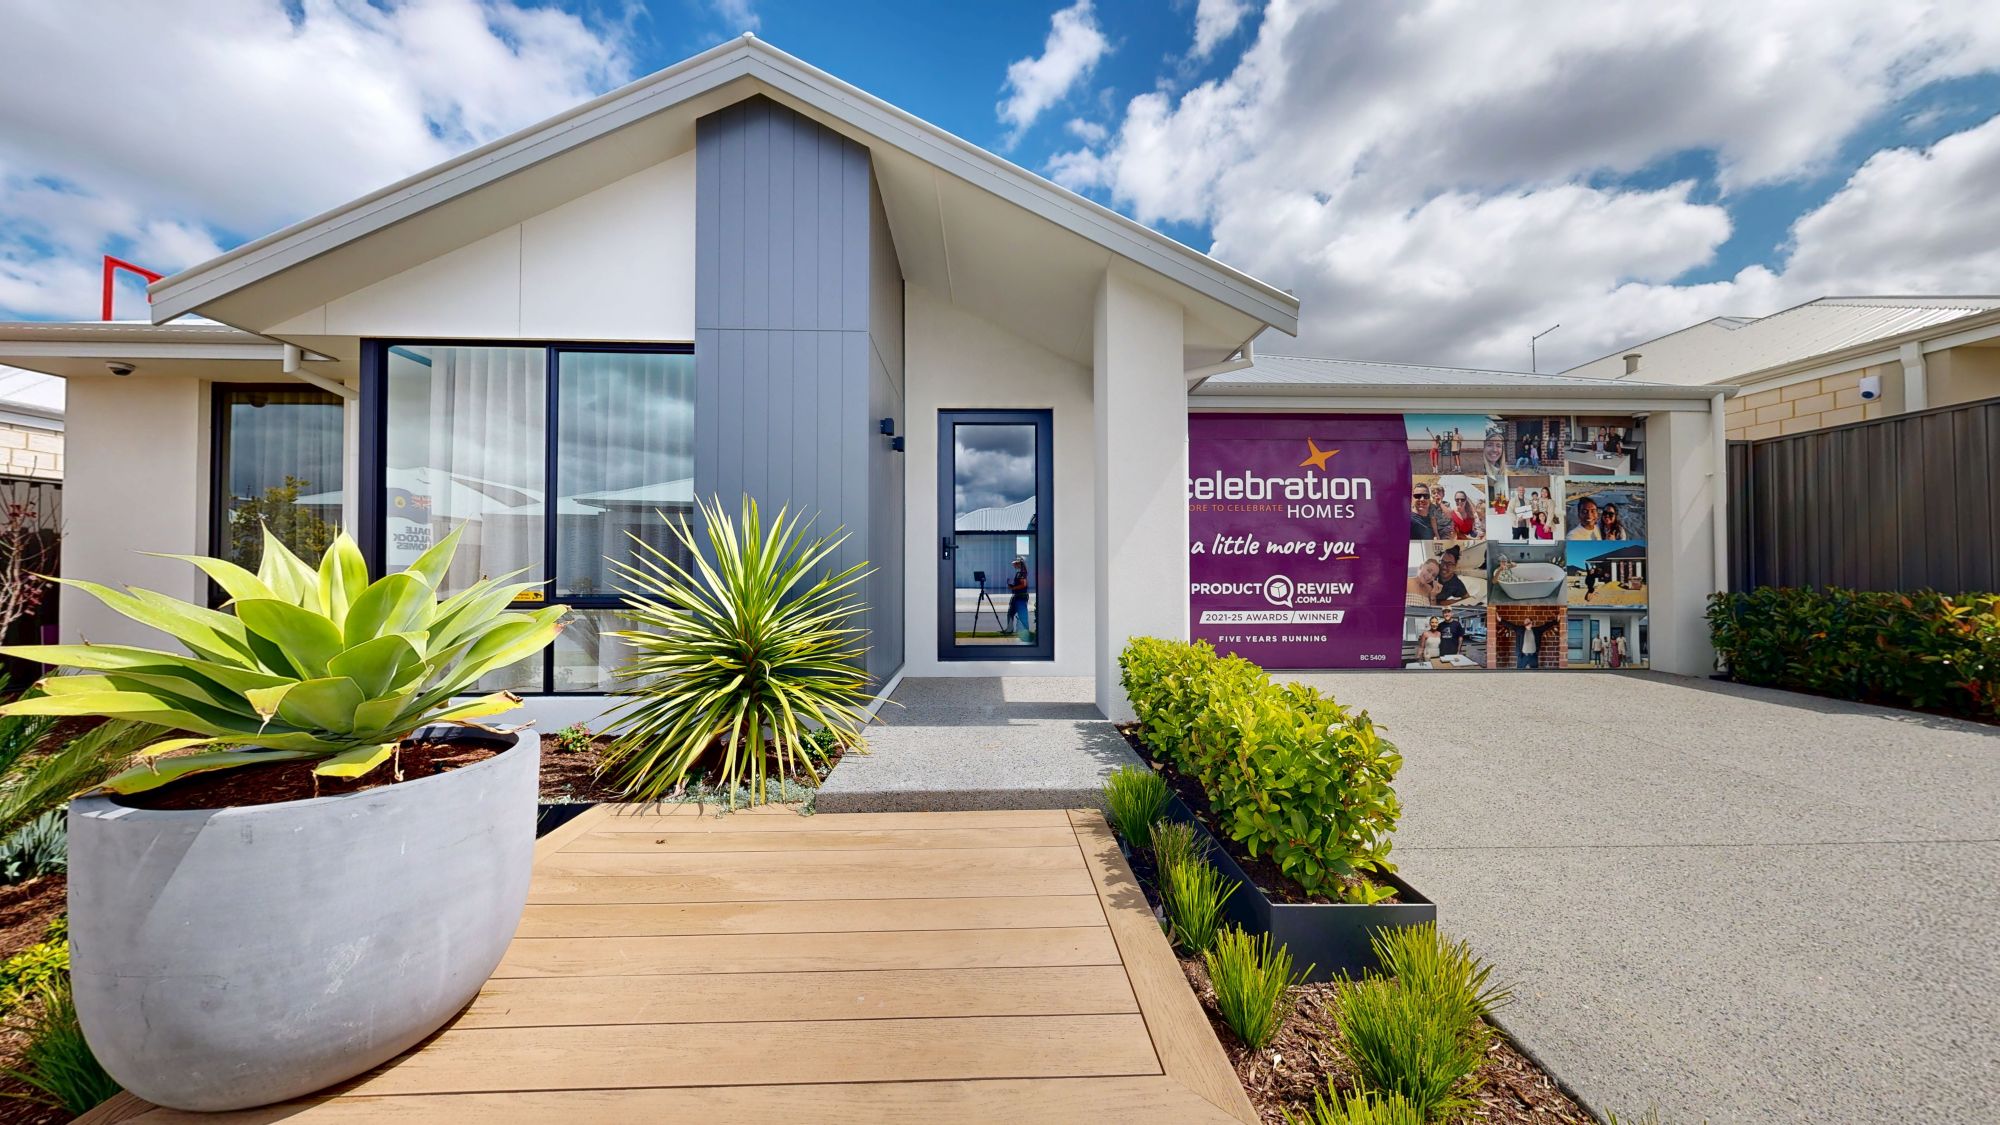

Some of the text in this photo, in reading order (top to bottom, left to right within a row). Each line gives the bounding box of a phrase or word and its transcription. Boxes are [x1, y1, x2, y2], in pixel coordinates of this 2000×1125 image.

[1189, 470, 1371, 499] elebration
[1189, 504, 1284, 512] ORE TO CELEBRATE
[1287, 504, 1355, 519] HOMES
[1190, 533, 1355, 560] a little more you
[1191, 583, 1354, 595] PRODUCT REVIEW
[1295, 596, 1332, 604] .COM.AU
[1205, 613, 1339, 621] 2021-25 AWARDS WINNER
[1219, 635, 1242, 643] FIVE
[1246, 635, 1278, 643] YEARS
